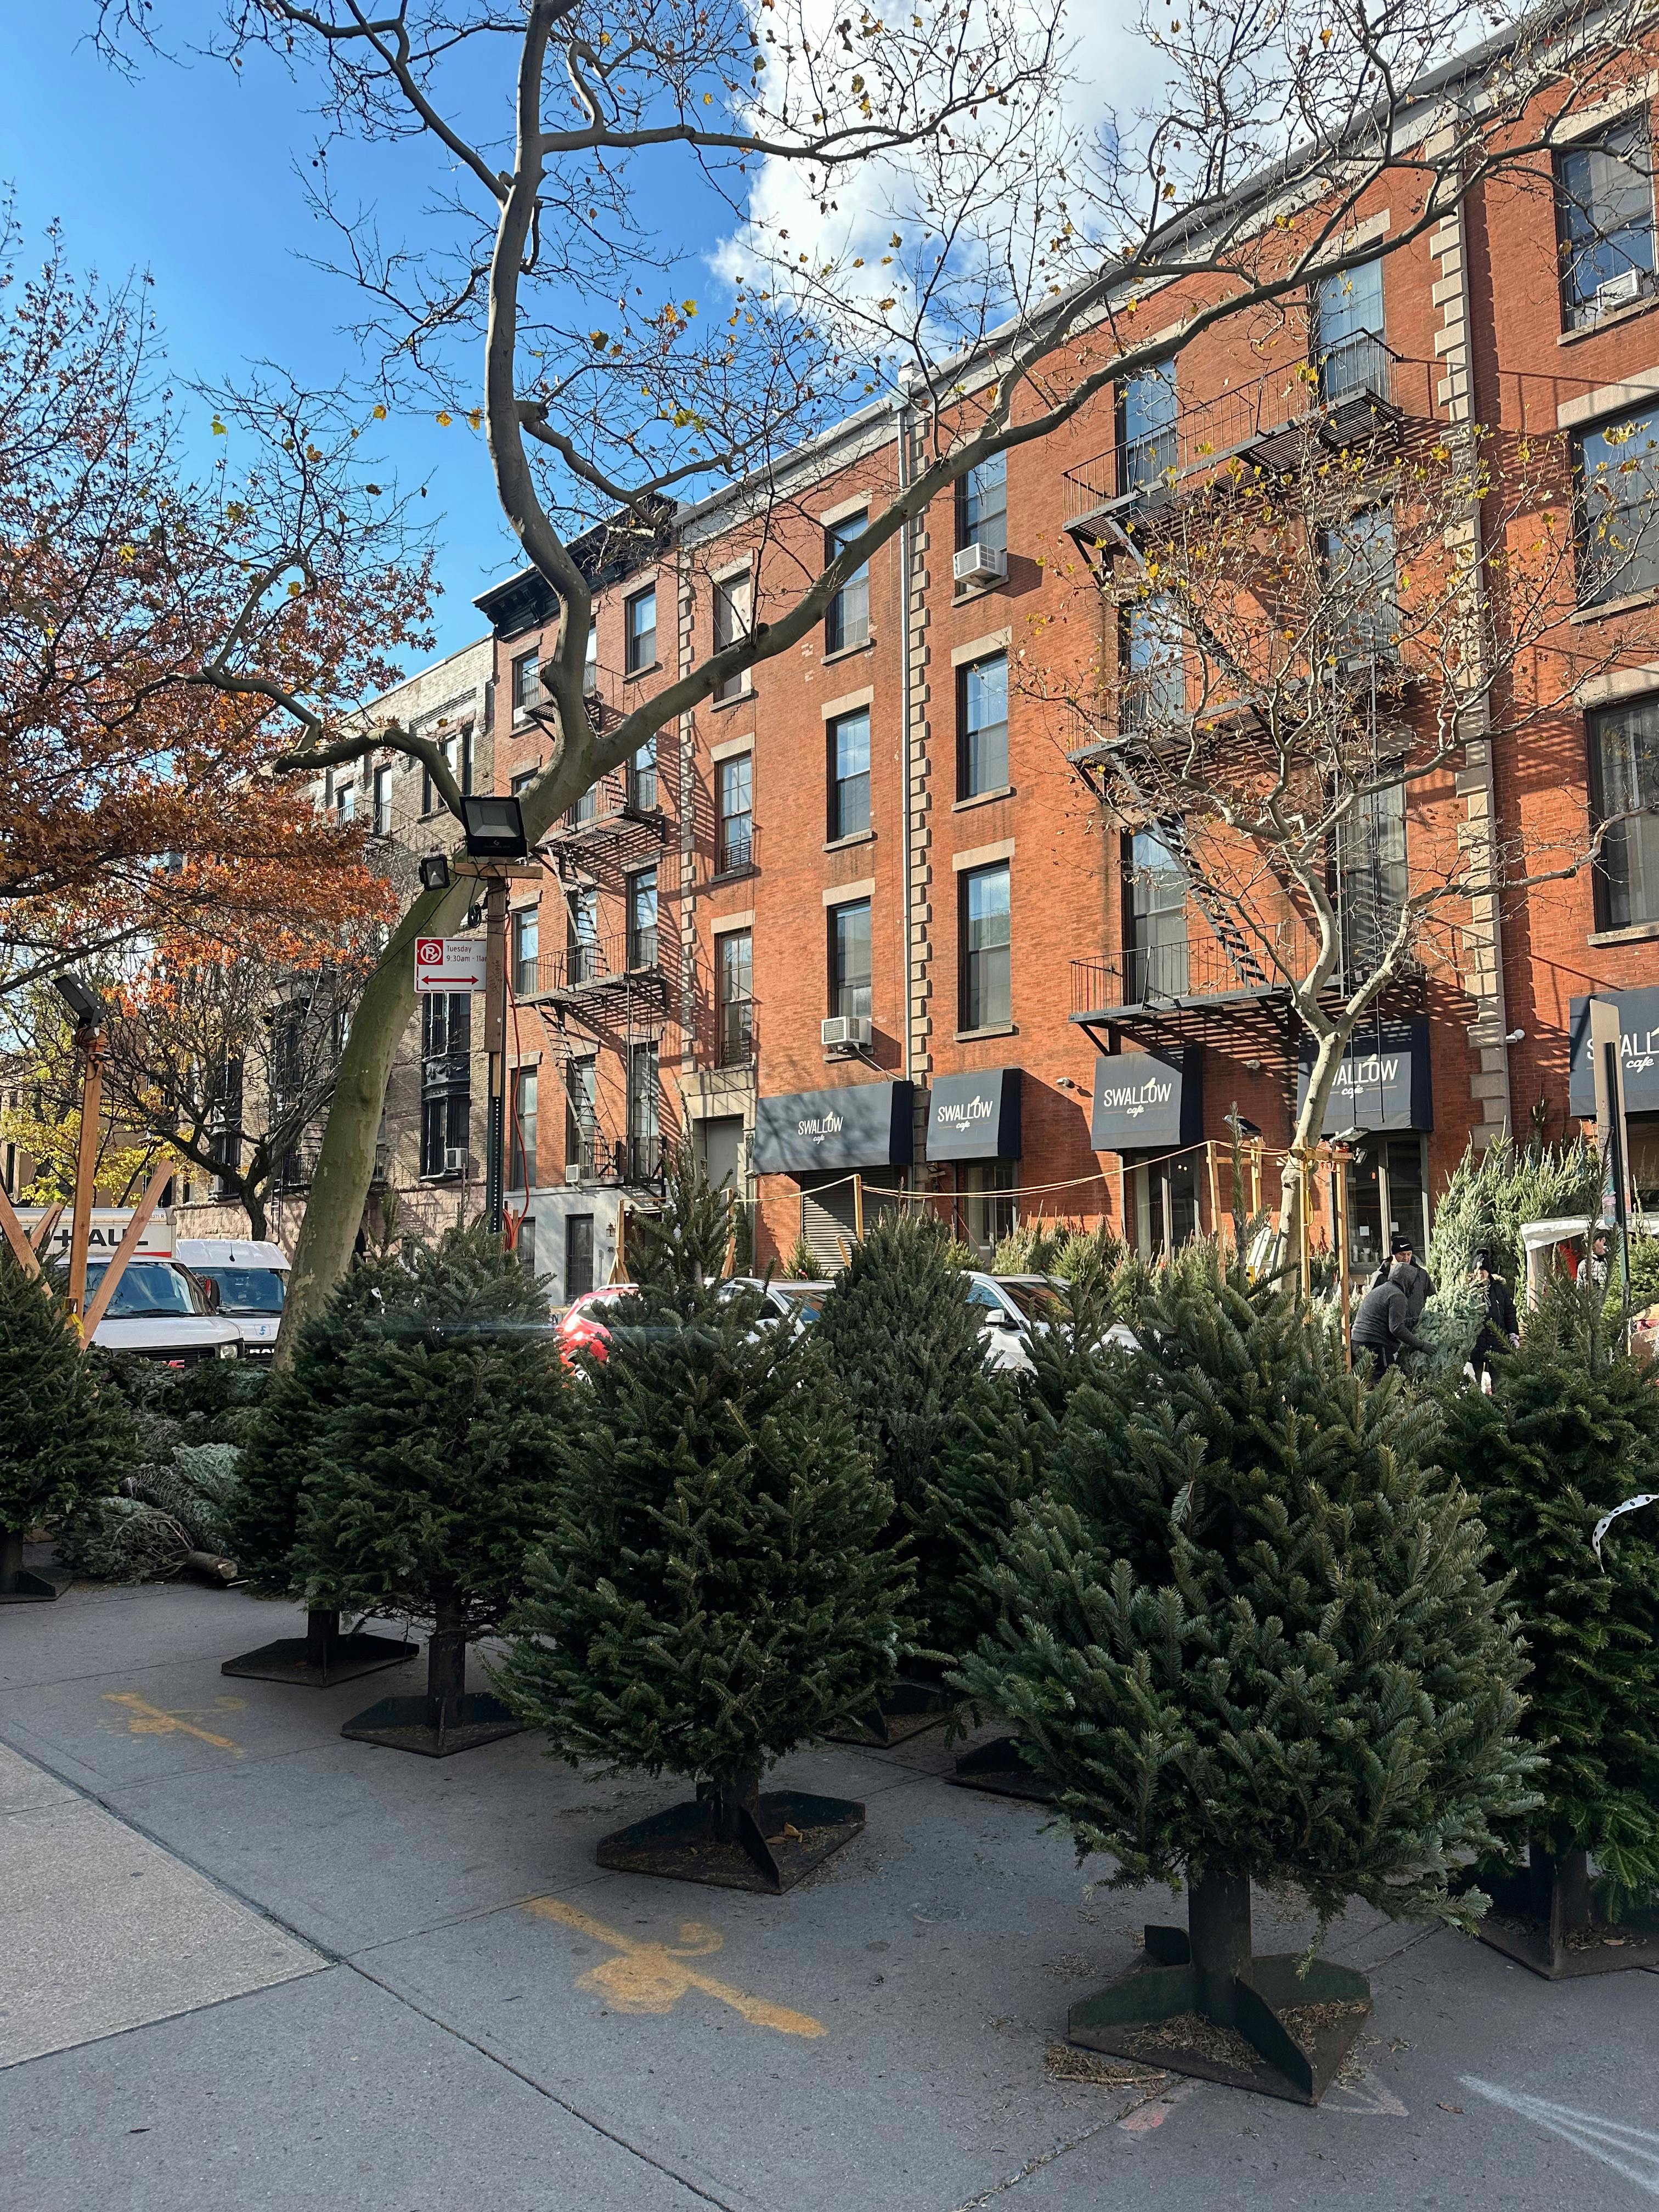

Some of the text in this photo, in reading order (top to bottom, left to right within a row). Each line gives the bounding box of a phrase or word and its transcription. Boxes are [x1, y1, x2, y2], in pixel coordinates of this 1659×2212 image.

[447, 945, 472, 953] Tuesday
[1332, 1059, 1398, 1086] ALLOW
[1104, 1082, 1172, 1107] SWALLOW
[938, 1100, 993, 1122] SWALLOW
[798, 1116, 844, 1135] SWALLOW
